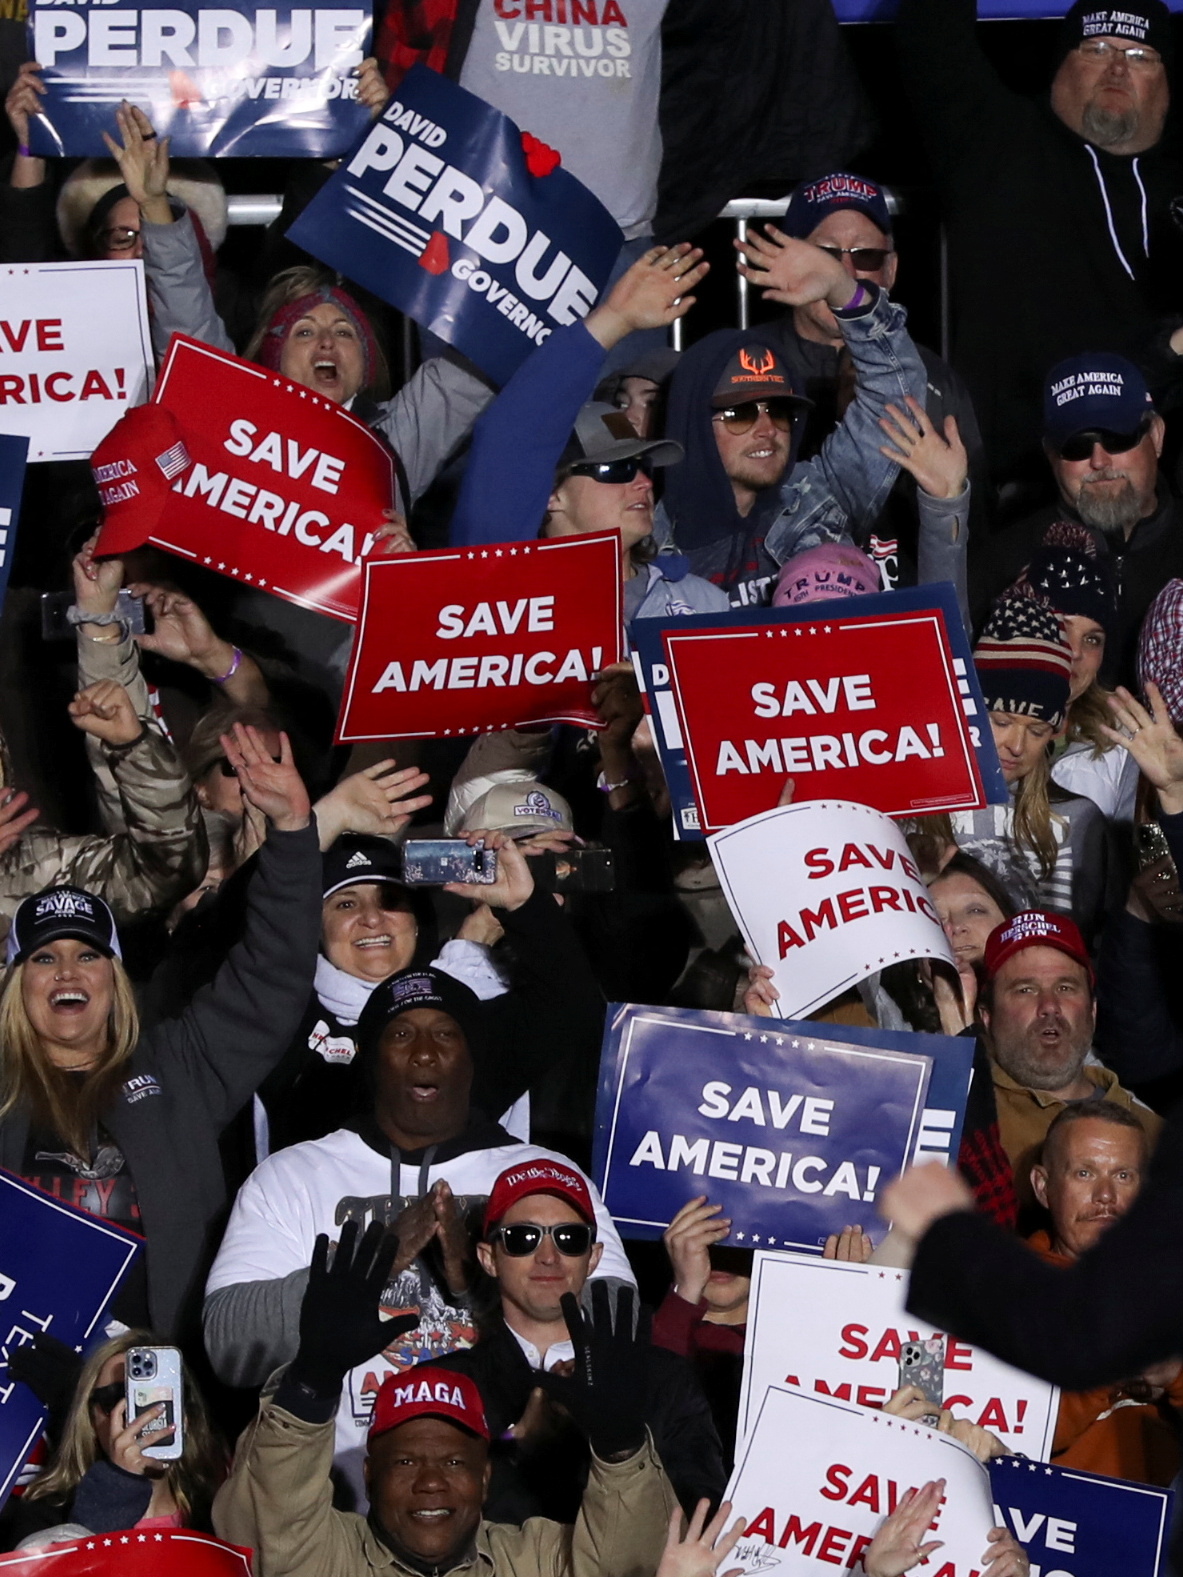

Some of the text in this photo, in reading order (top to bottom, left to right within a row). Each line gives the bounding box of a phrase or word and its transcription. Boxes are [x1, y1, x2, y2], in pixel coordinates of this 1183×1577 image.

[494, 0, 627, 27] CHINA
[1082, 10, 1149, 30] MAKE AMERICA
[35, 9, 365, 68] PERDUE
[494, 21, 632, 58] VIRUS
[1083, 23, 1146, 39] GREAT AGAIN
[495, 52, 632, 78] SURVIVOR
[208, 78, 359, 100] GOVERNOR
[383, 101, 448, 148] DAVID
[804, 177, 878, 203] TRUMP
[346, 122, 599, 327] PERDUE
[0, 318, 64, 355] VE
[1051, 371, 1124, 397] MAKE AMERICA
[1056, 384, 1122, 407] GREAT AGAIN
[223, 419, 346, 496] SAVE
[784, 571, 866, 600] TRUMP
[435, 595, 555, 640] SAVE
[371, 646, 602, 694] AMERICA!
[751, 674, 876, 718] SAVE
[716, 723, 945, 776] AMERICA!
[346, 859, 372, 869] adidas
[804, 842, 922, 886] SAVE
[35, 897, 94, 916] SAVAGE
[1012, 913, 1045, 927] RUN
[1001, 921, 1061, 943] HERSCHEL
[1013, 930, 1047, 943] RUN
[698, 1080, 835, 1137] SAVE
[629, 1130, 881, 1203] AMERICA!
[393, 1381, 467, 1410] MAGA
